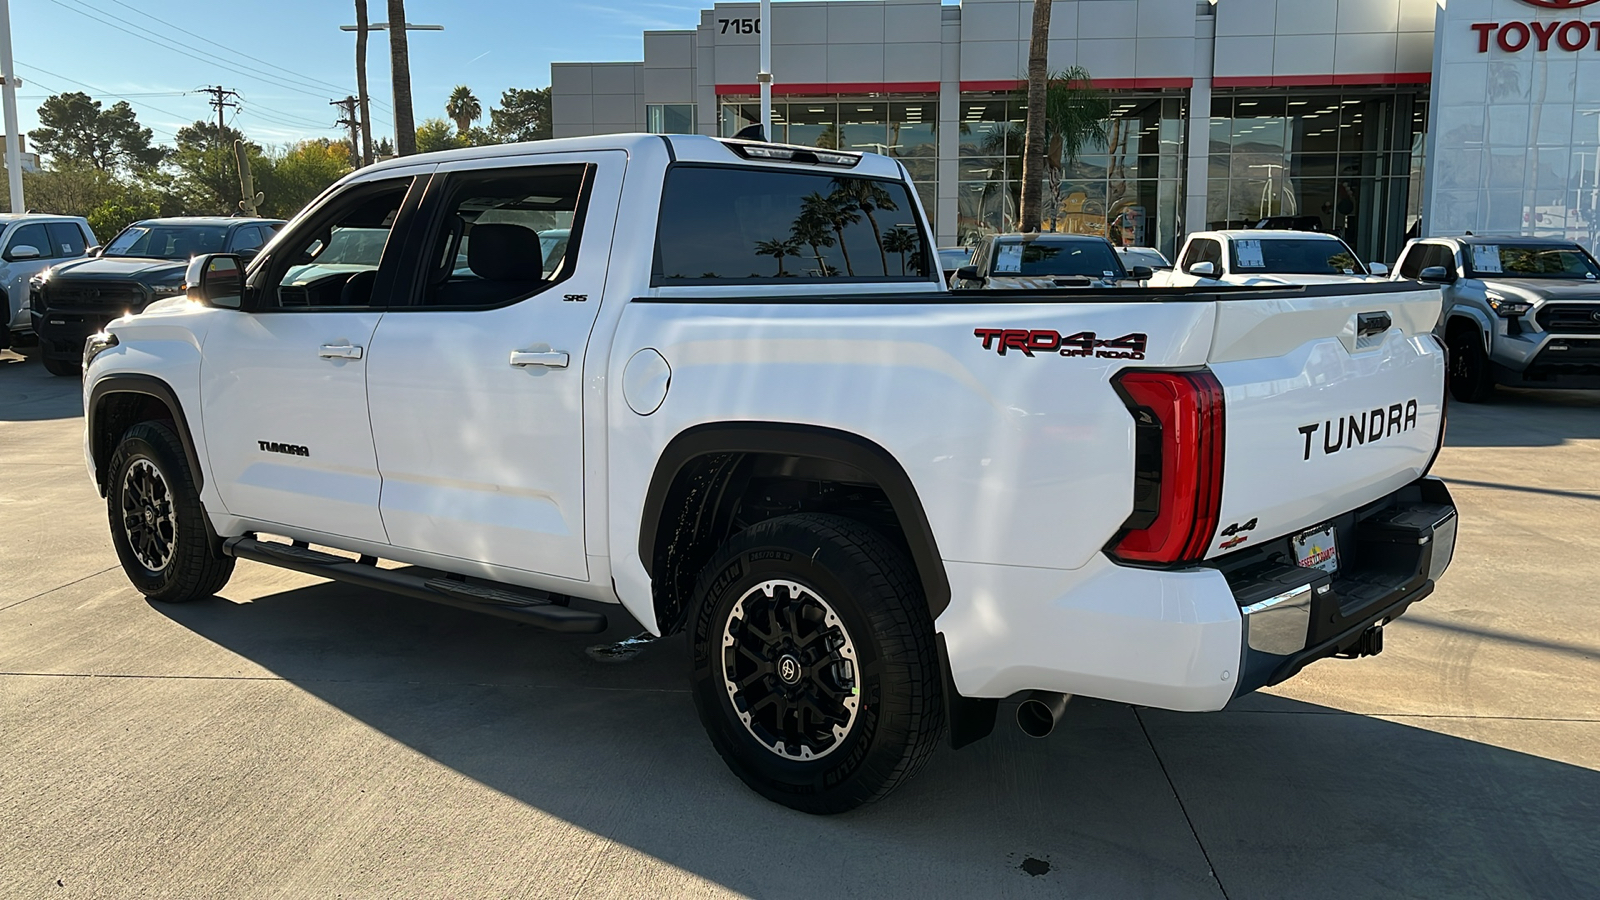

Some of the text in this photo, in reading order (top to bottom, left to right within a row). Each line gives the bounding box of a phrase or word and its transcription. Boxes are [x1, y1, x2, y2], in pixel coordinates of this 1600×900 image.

[974, 328, 1063, 357] TRD
[1059, 349, 1146, 360] OFF ROAD
[257, 440, 310, 457] TUNDRA
[1298, 398, 1418, 461] TUNDRA
[697, 562, 741, 638] MICHELIN
[825, 708, 877, 787] MICHELIN
